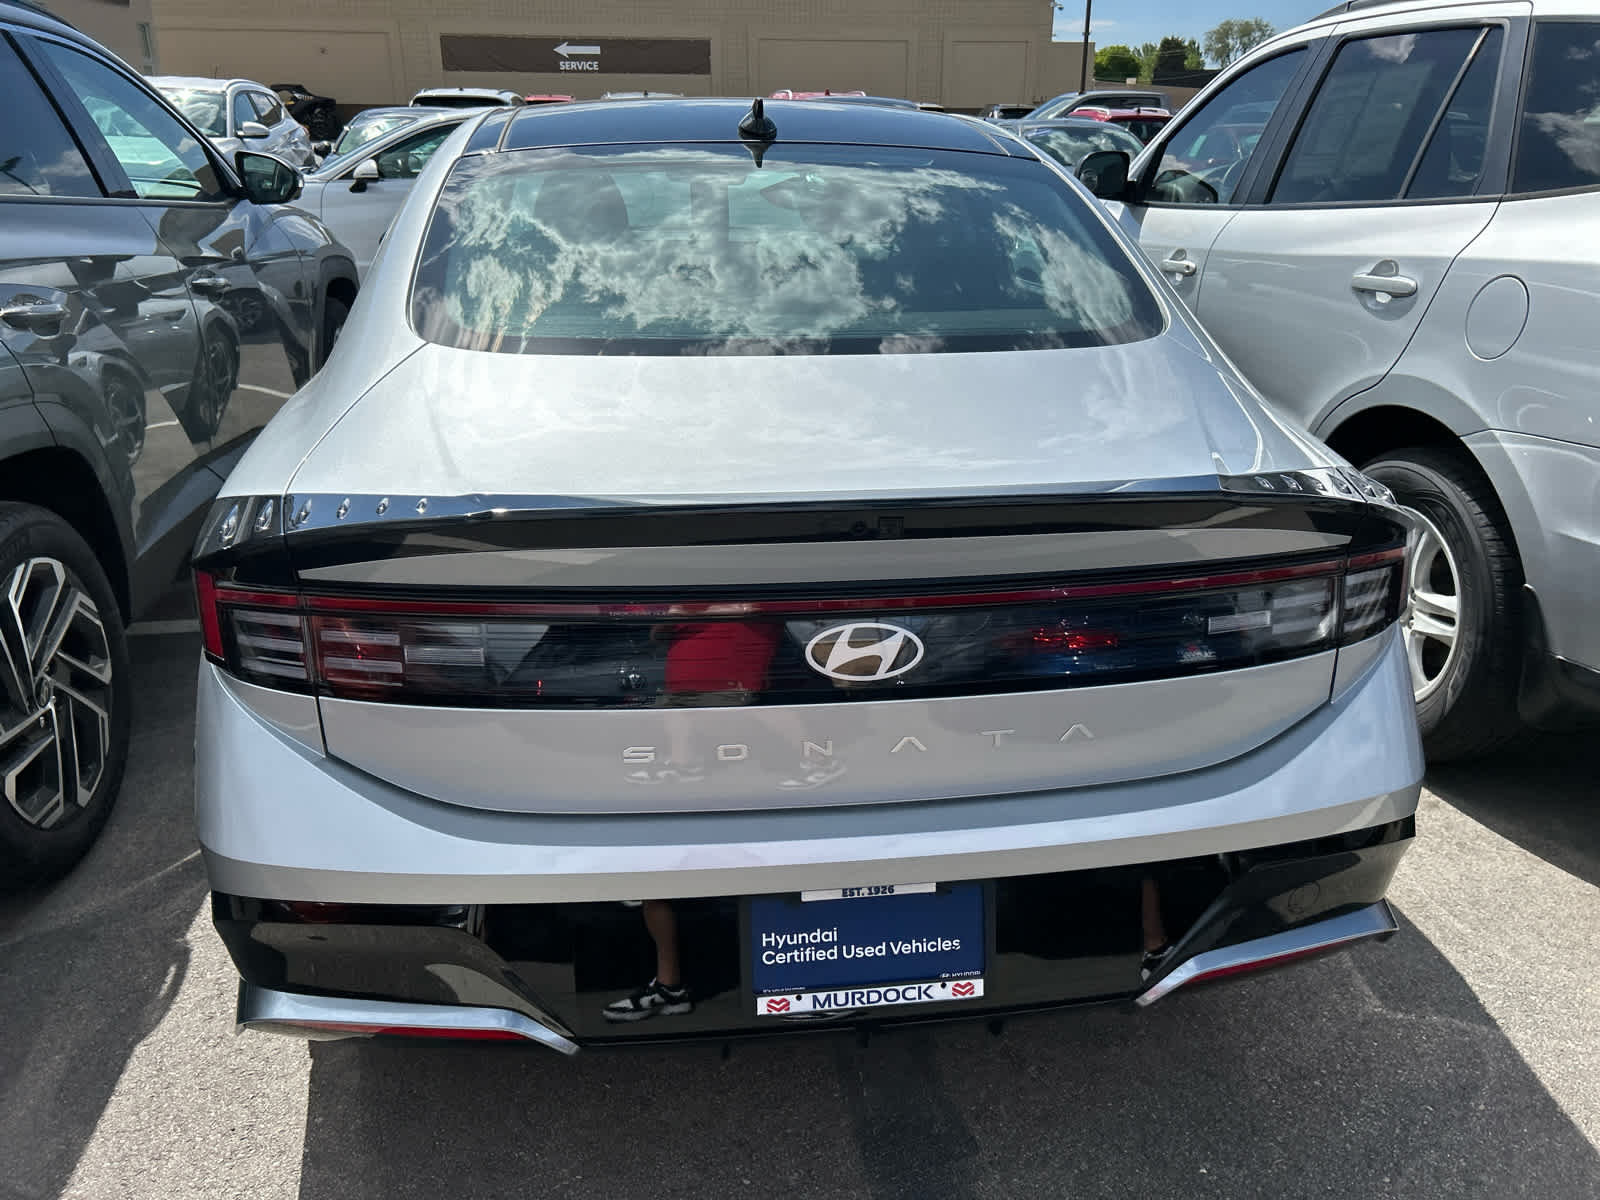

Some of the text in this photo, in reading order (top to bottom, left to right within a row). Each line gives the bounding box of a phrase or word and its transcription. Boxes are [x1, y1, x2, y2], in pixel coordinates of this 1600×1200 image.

[559, 61, 599, 71] SERVICE
[623, 723, 1095, 763] SONATA
[841, 884, 895, 898] EST. 1926
[762, 927, 839, 949] Hyundai
[762, 937, 961, 966] Certified Used Vehicles
[812, 984, 934, 1010] MURDOCK
